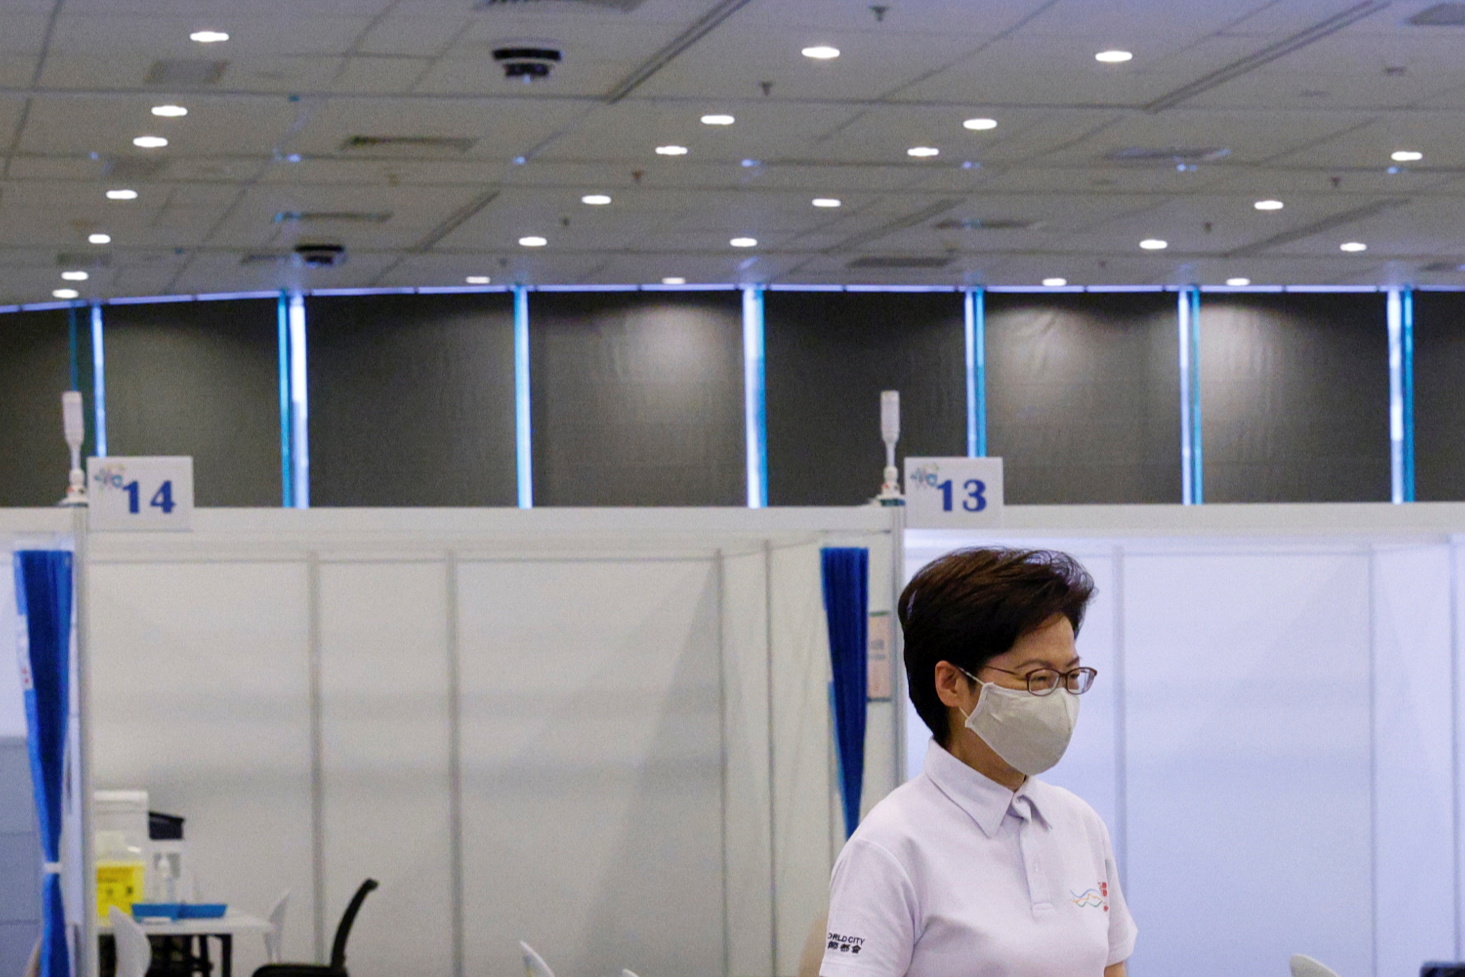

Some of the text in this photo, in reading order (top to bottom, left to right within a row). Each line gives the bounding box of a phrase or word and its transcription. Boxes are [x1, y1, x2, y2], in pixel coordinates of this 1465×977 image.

[122, 479, 176, 514] 14
[937, 478, 987, 512] 13
[827, 932, 866, 946] ORLD CITY
